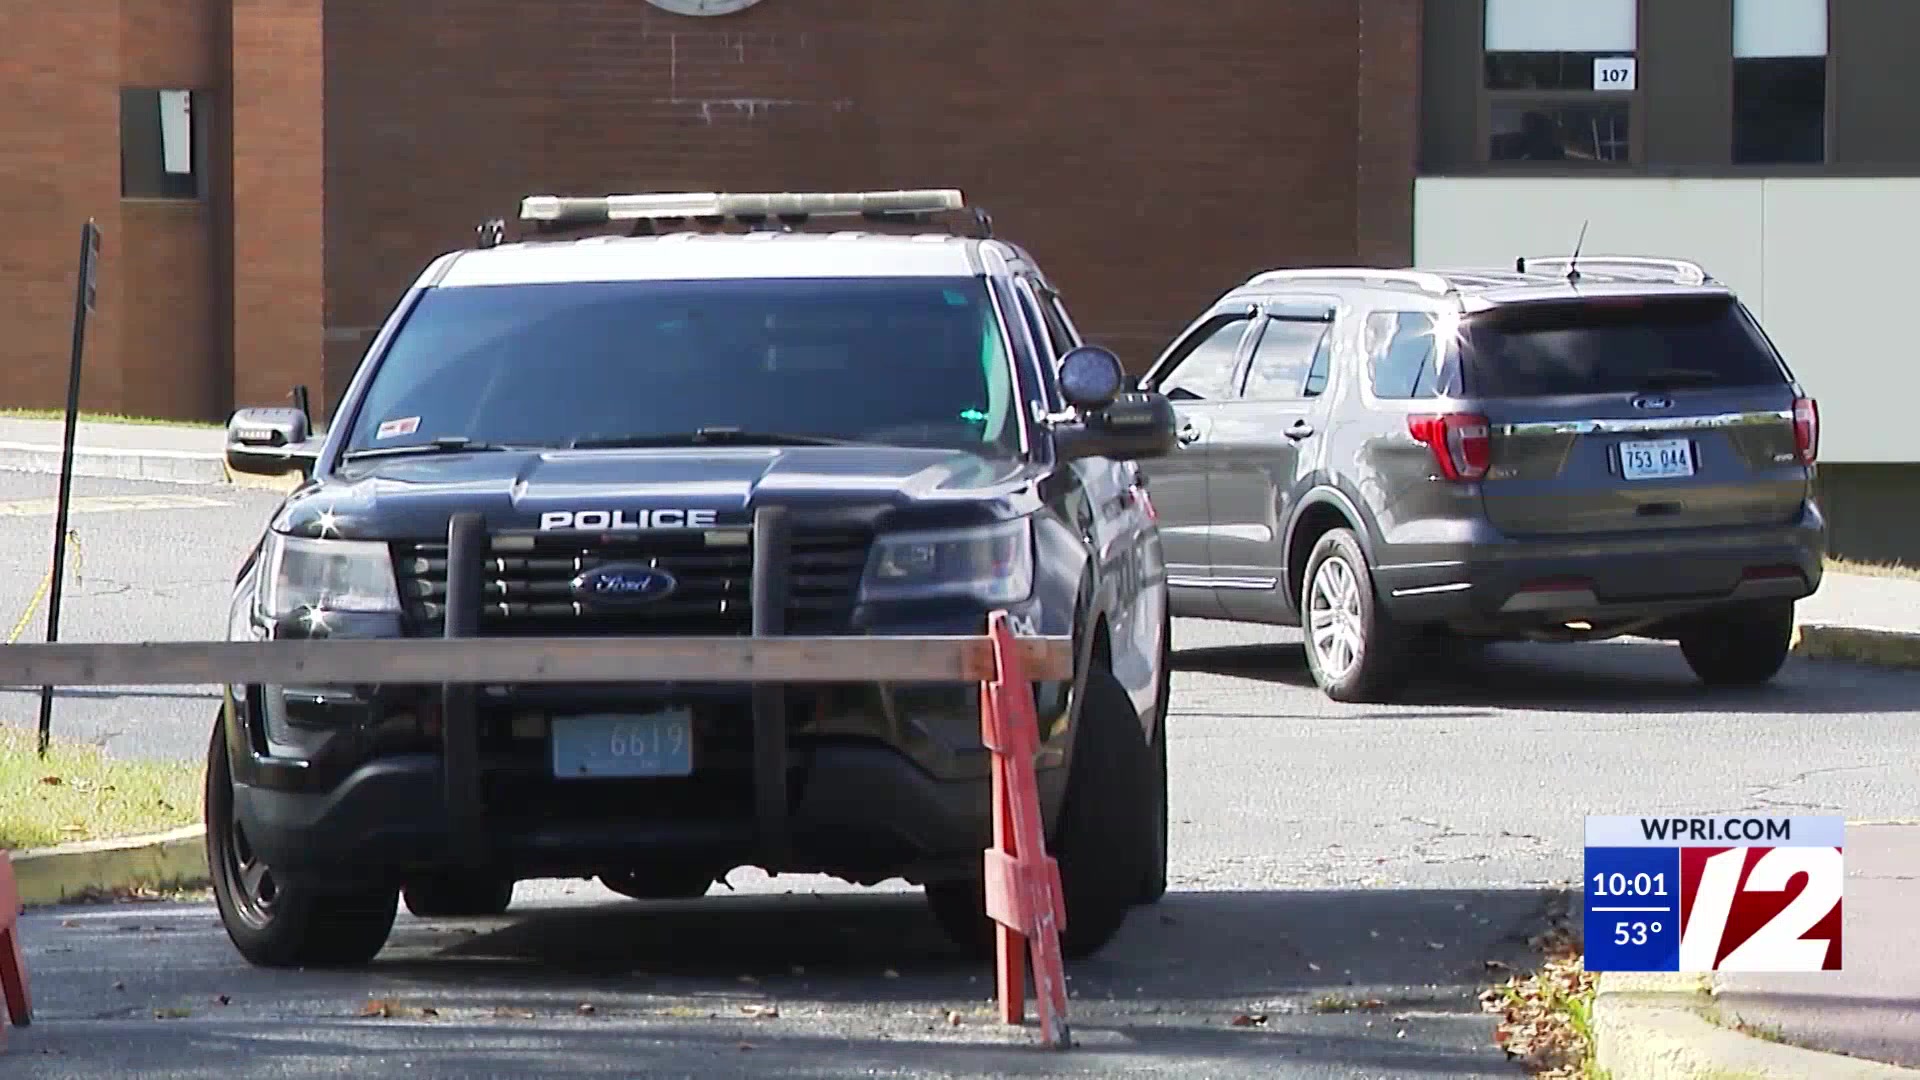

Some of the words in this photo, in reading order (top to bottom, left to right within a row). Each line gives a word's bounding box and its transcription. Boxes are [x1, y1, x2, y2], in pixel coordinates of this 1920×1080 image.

[1602, 69, 1628, 82] 107
[1626, 450, 1652, 469] 753
[1661, 448, 1686, 468] 044
[539, 509, 718, 531] POLICE
[596, 574, 652, 592] Ford
[611, 722, 683, 757] 6619
